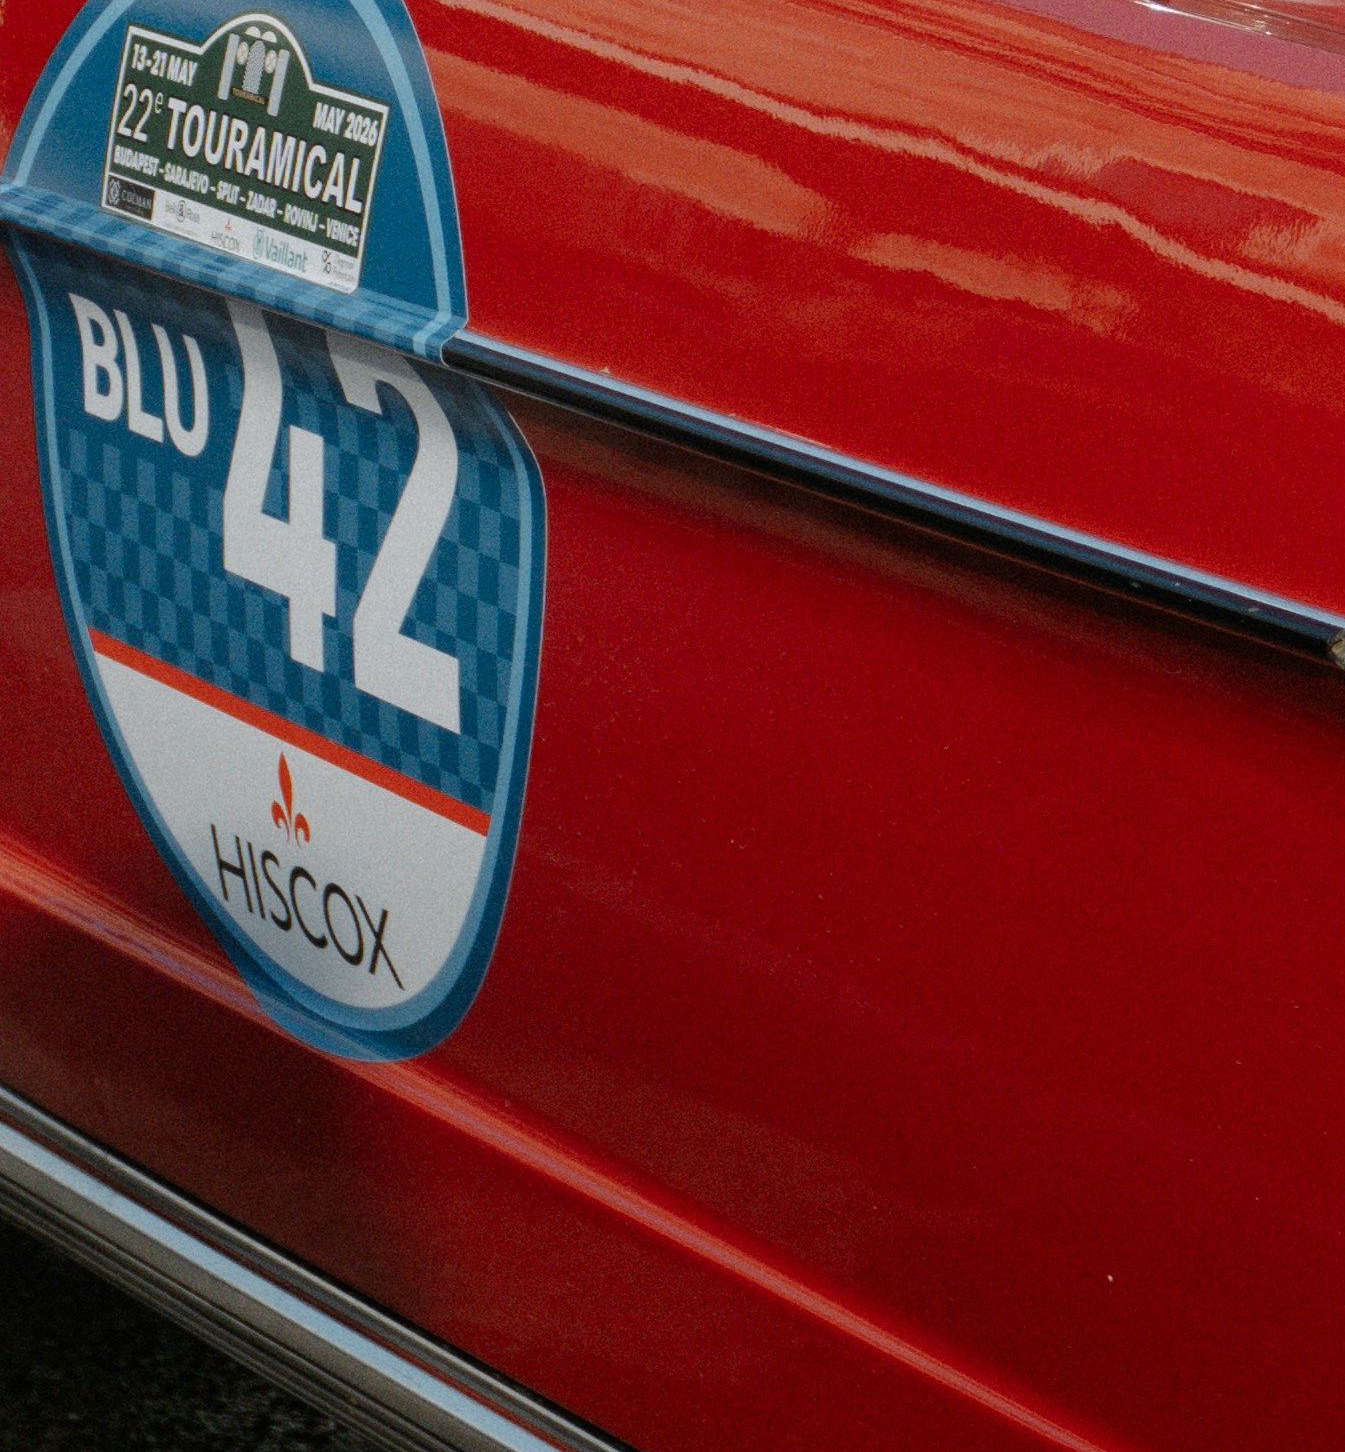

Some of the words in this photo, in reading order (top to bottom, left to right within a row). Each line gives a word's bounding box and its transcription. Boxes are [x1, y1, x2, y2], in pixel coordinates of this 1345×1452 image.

[132, 43, 167, 78] 13-21
[167, 55, 199, 87] MAY
[167, 97, 362, 214] TOURAMICAL
[312, 102, 346, 136] MAY
[345, 112, 379, 147] 2026
[113, 145, 160, 178] BUDAPEST
[164, 161, 210, 195] SARAJEVO
[216, 179, 241, 205] SPLIT
[246, 190, 277, 219] ZADAR
[283, 203, 319, 233] ROVINJ
[327, 217, 360, 247] VENICE
[265, 236, 308, 273] Vaillant
[68, 292, 210, 458] BLU
[222, 297, 461, 735] 42
[209, 823, 405, 991] HISCOX
